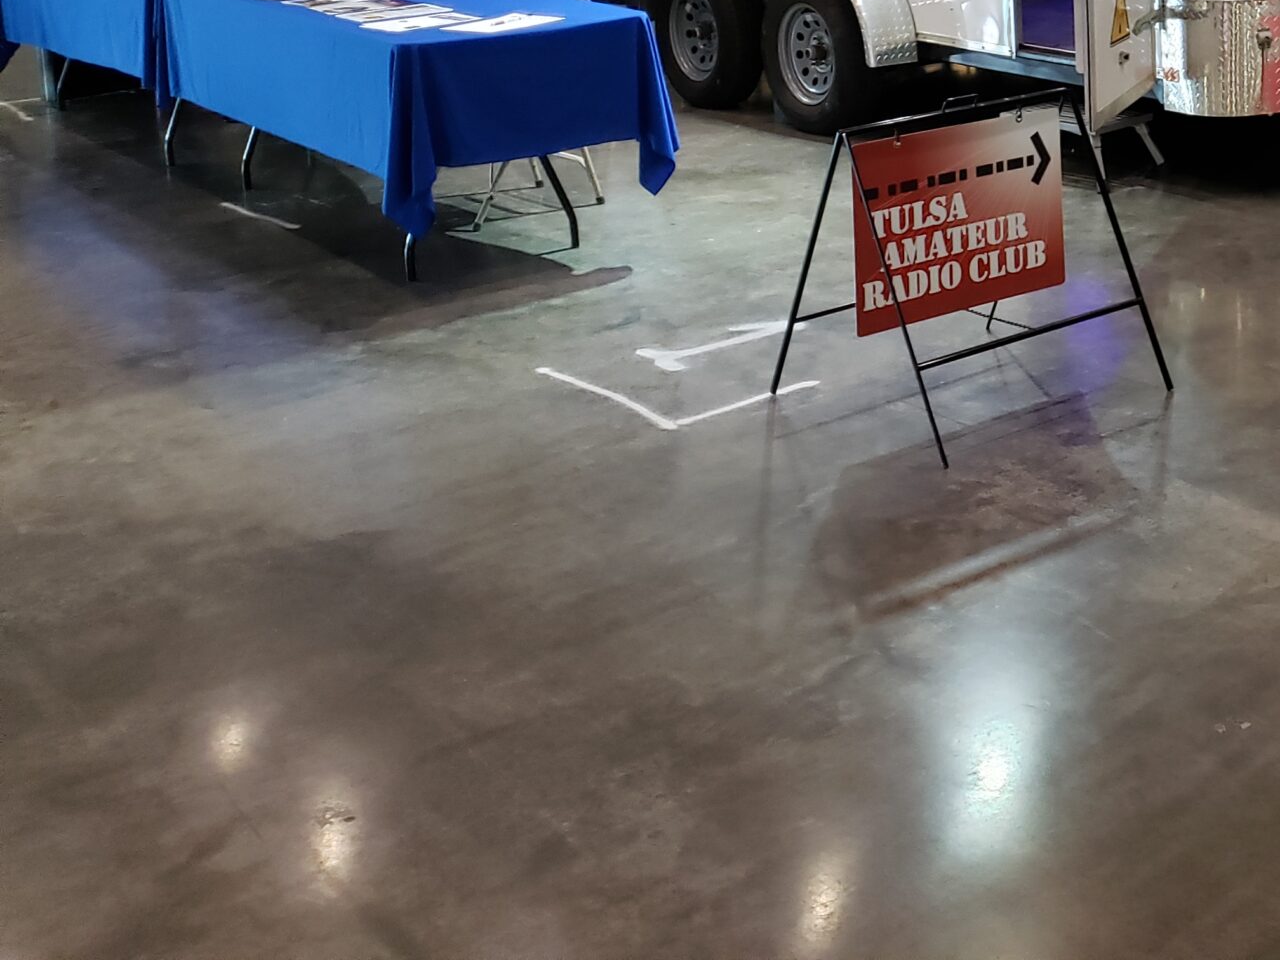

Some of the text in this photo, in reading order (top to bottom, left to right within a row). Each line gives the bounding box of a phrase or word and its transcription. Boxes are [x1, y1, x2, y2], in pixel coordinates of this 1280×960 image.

[871, 192, 968, 239] TULSA
[880, 212, 1028, 273] AMATEUR
[863, 240, 1047, 312] RADIO CLUB
